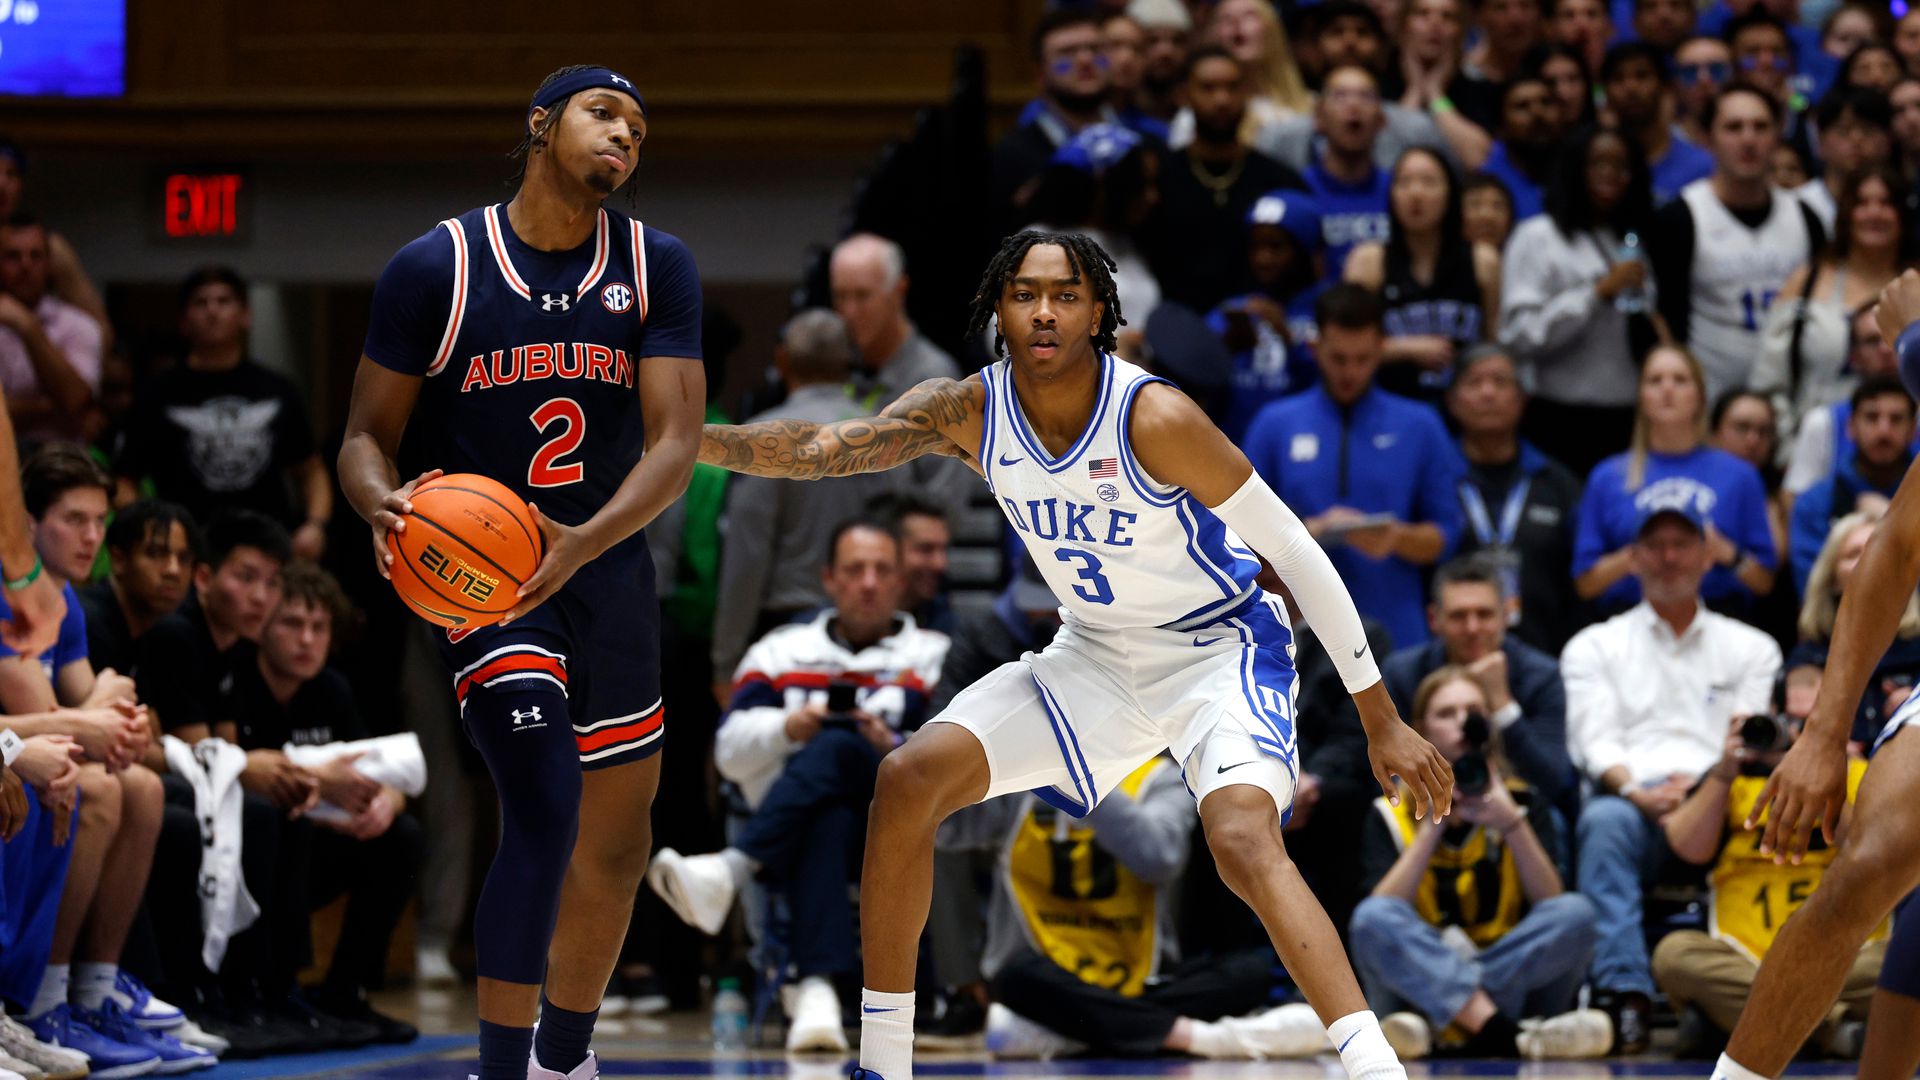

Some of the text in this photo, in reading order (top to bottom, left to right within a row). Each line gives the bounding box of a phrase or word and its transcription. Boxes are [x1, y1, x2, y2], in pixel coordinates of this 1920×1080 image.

[165, 174, 242, 237] EXIT
[603, 284, 631, 311] SEC
[461, 342, 635, 393] AUBURN
[527, 396, 586, 488] 2
[1002, 496, 1138, 547] DUKE
[418, 544, 497, 604] ELITE
[1053, 547, 1116, 606] 3
